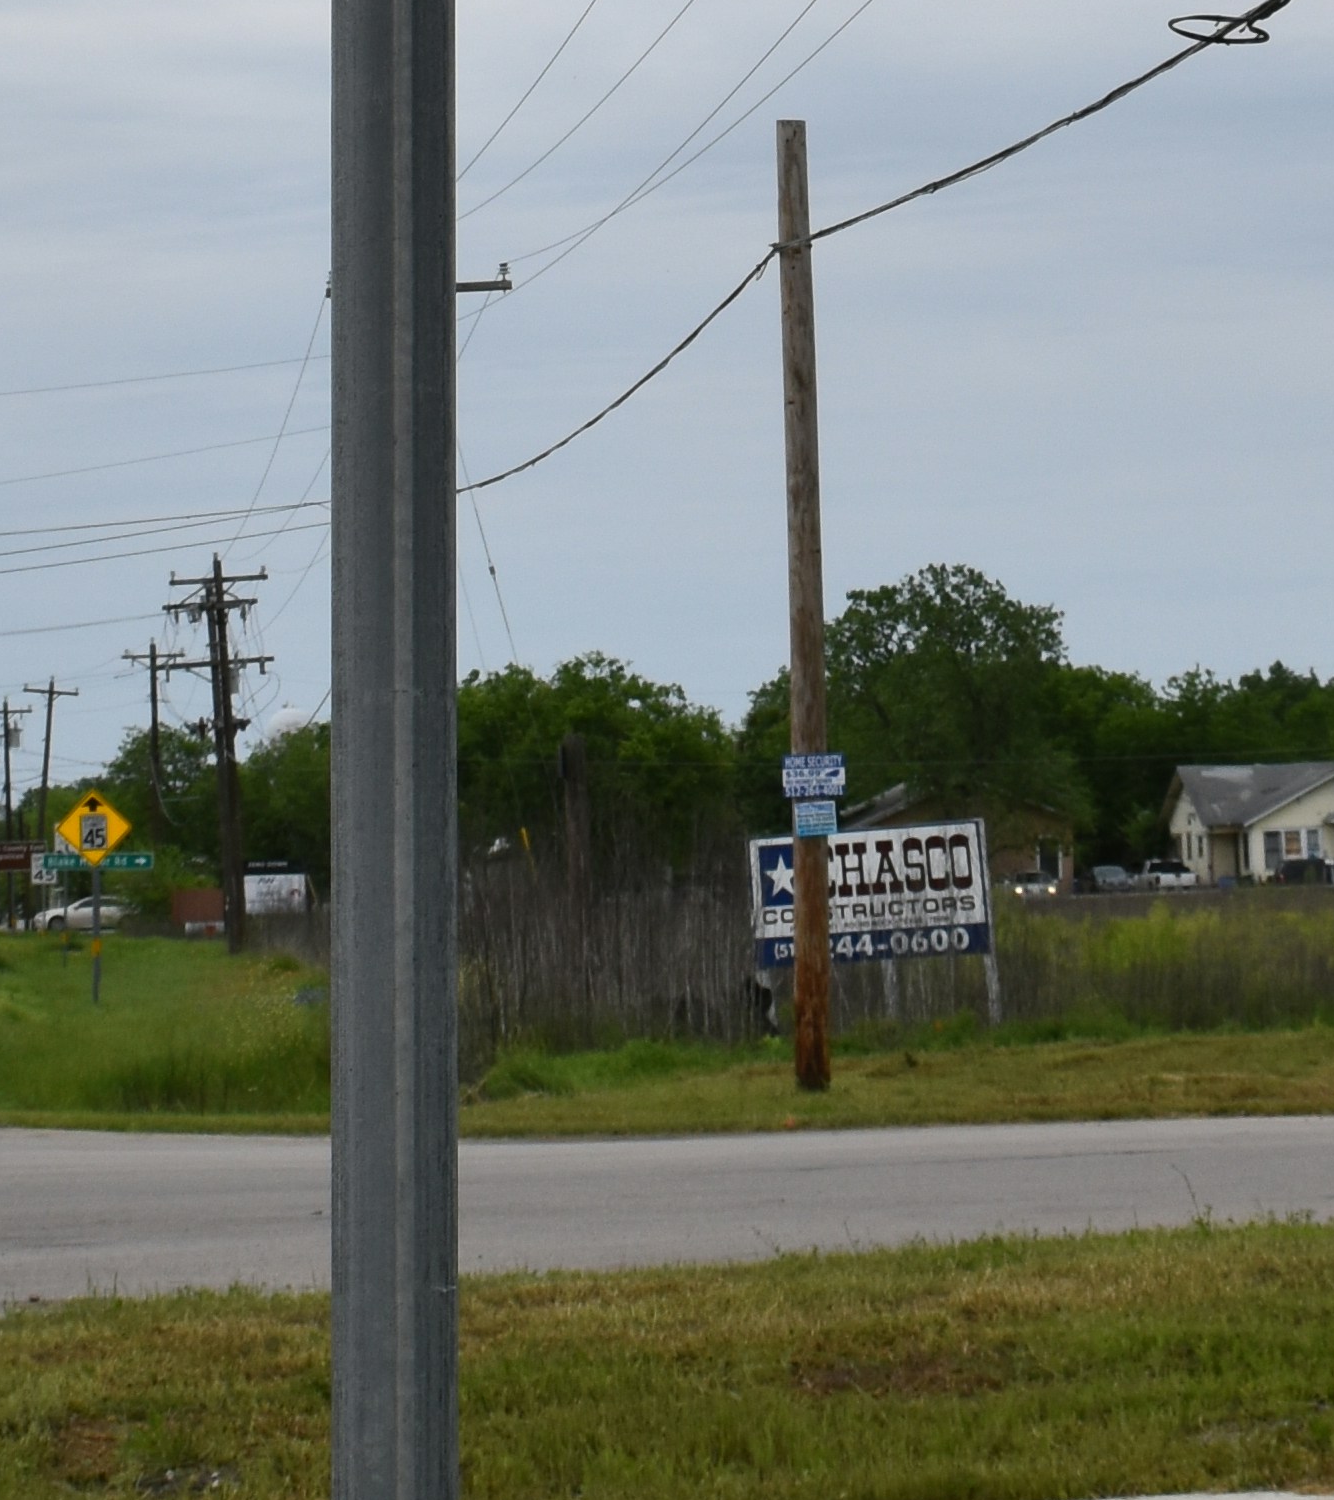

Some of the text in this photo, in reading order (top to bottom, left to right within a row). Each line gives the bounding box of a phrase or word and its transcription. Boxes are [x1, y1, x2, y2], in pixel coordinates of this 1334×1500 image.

[785, 755, 842, 769] HOME SECURITY
[83, 829, 106, 848] 45
[33, 869, 55, 881] 45
[763, 895, 976, 925] COTRUCTORS
[829, 926, 970, 958] 44-0600
